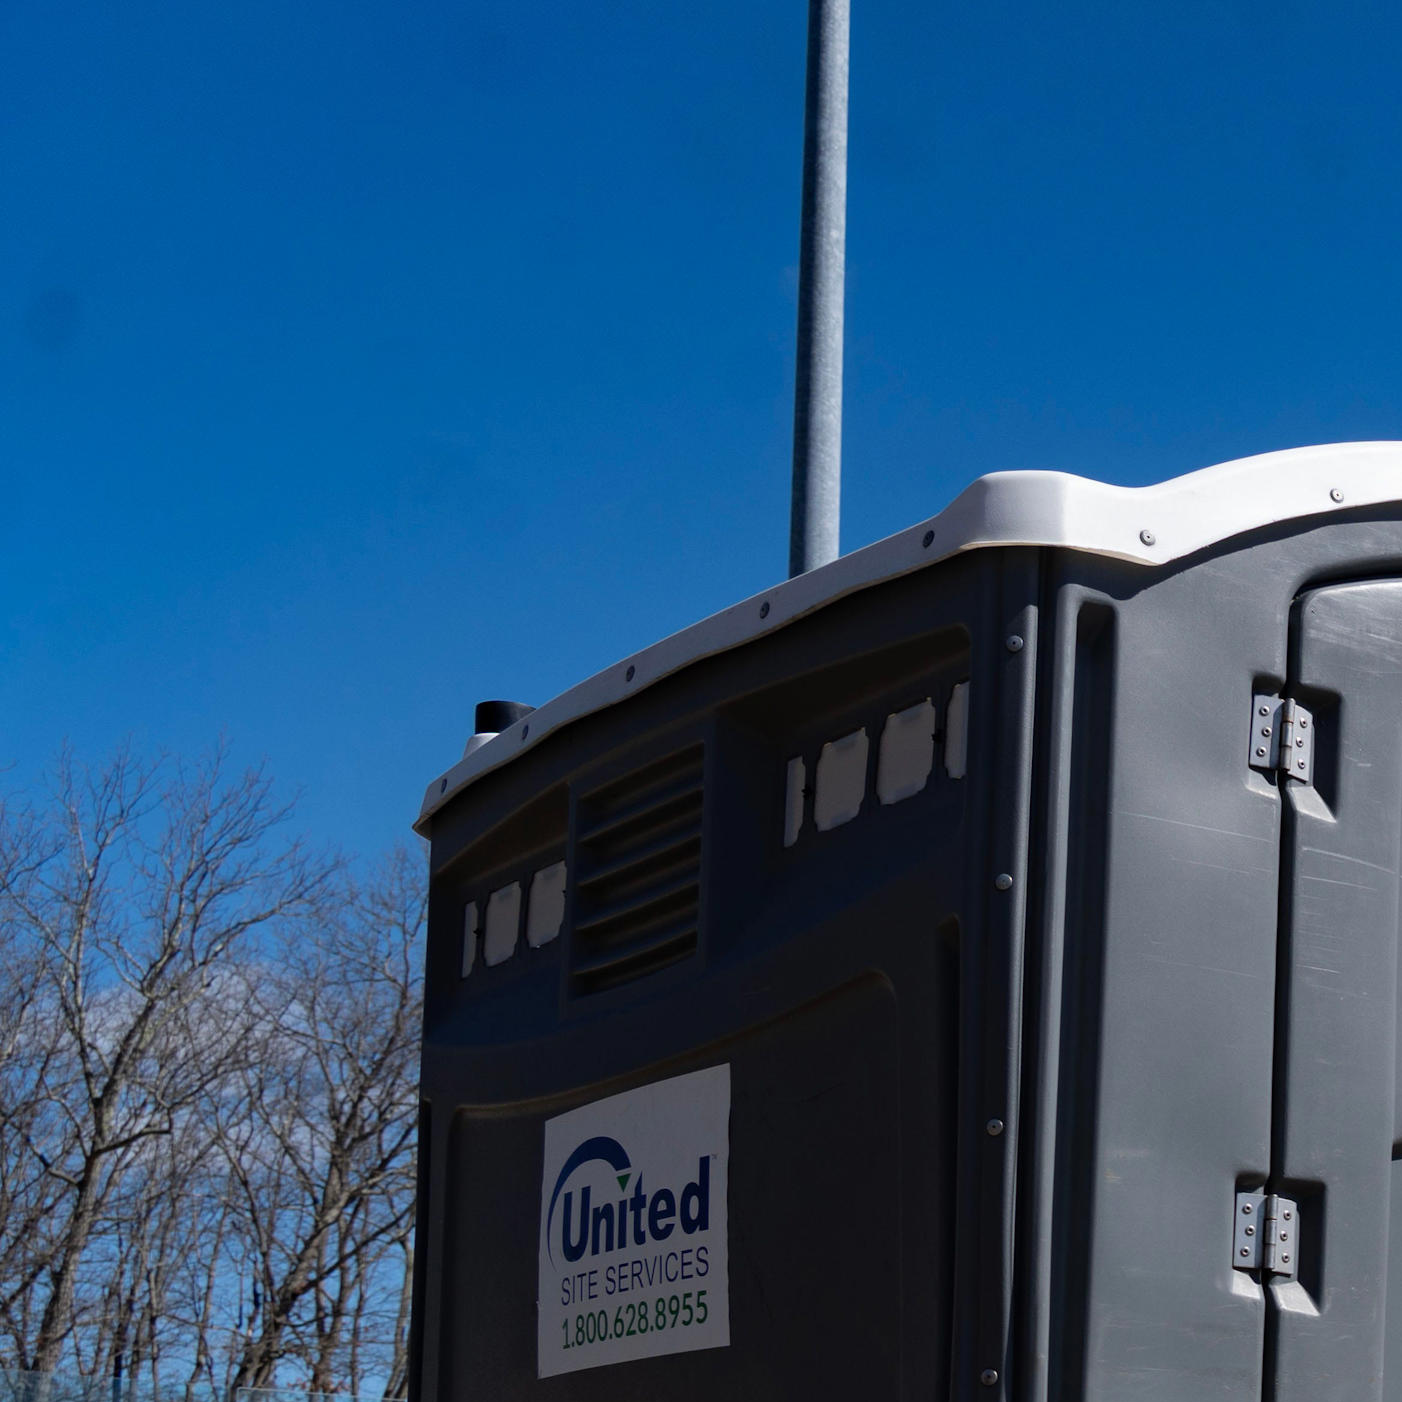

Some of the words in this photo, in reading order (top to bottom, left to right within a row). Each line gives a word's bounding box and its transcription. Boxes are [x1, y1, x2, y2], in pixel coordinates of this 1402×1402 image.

[562, 1155, 710, 1262] United
[561, 1270, 598, 1306] SITE
[605, 1246, 709, 1296] SERVICES
[562, 1290, 709, 1349] 1.800.628.8955
